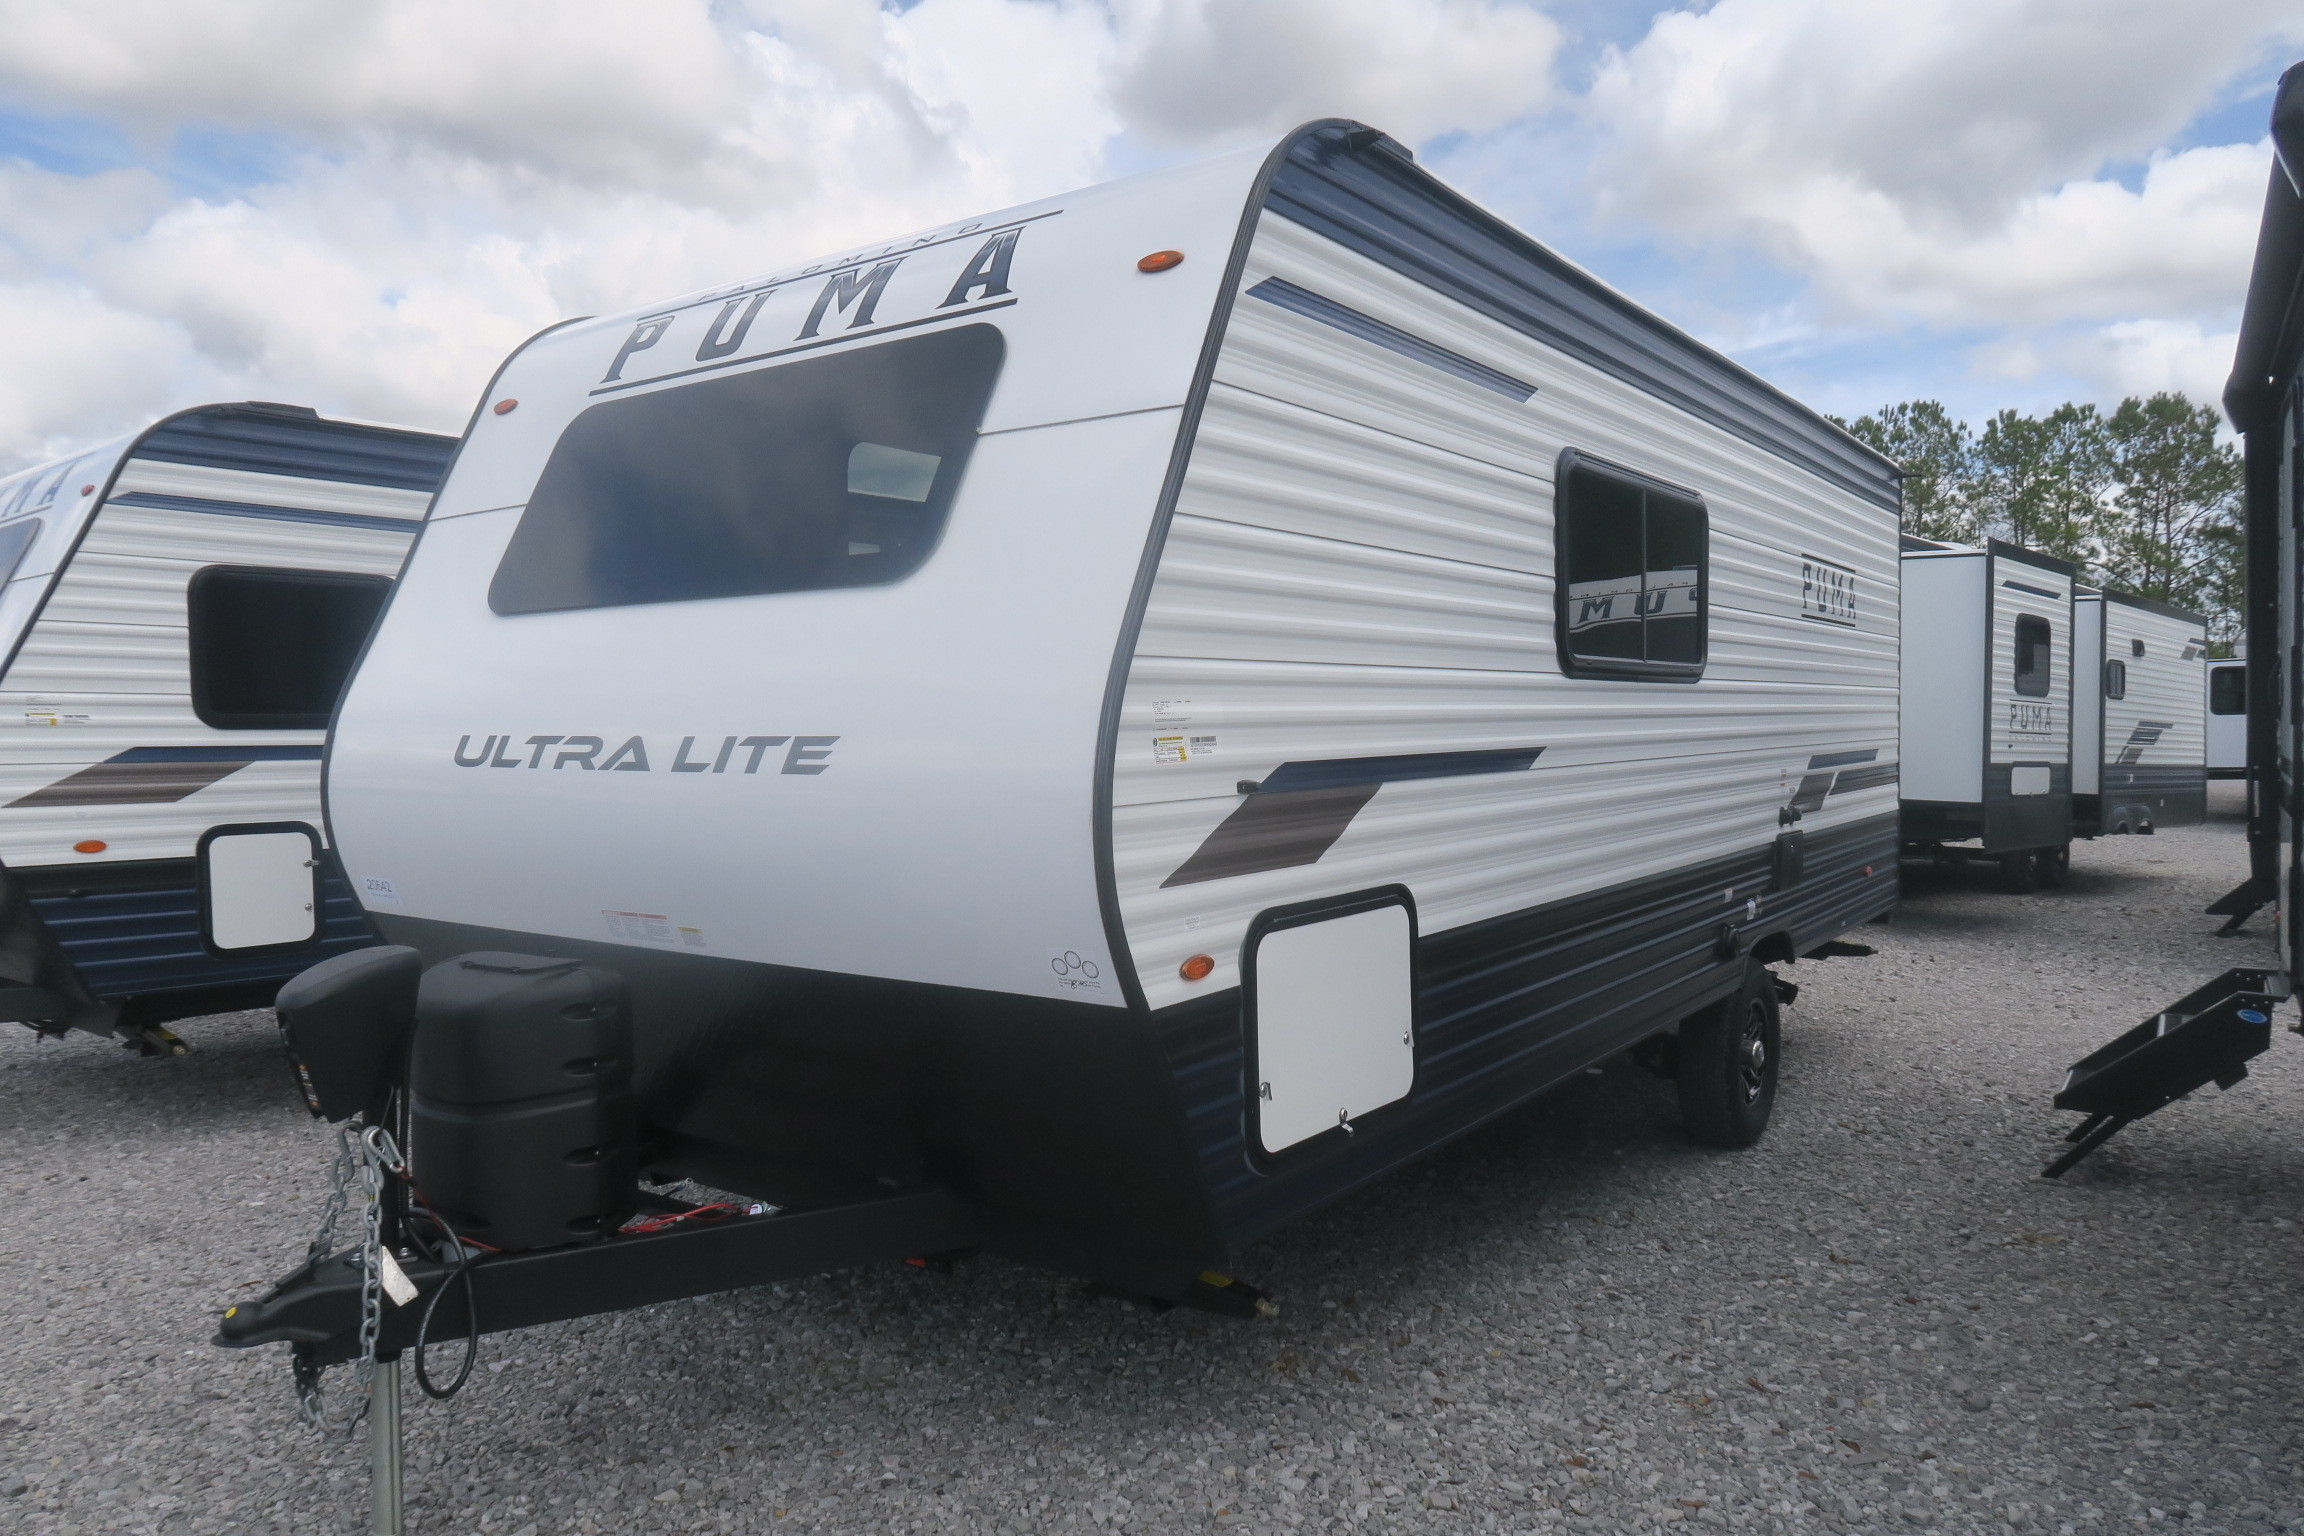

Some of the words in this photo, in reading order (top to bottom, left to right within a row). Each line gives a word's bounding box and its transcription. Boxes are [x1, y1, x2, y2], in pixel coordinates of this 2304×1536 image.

[599, 226, 1027, 384] PUMA
[0, 459, 79, 518] MA
[1802, 562, 1857, 620] PUMA
[2009, 703, 2052, 731] PUMA
[453, 734, 651, 773] ULTRA
[670, 735, 841, 776] LITE
